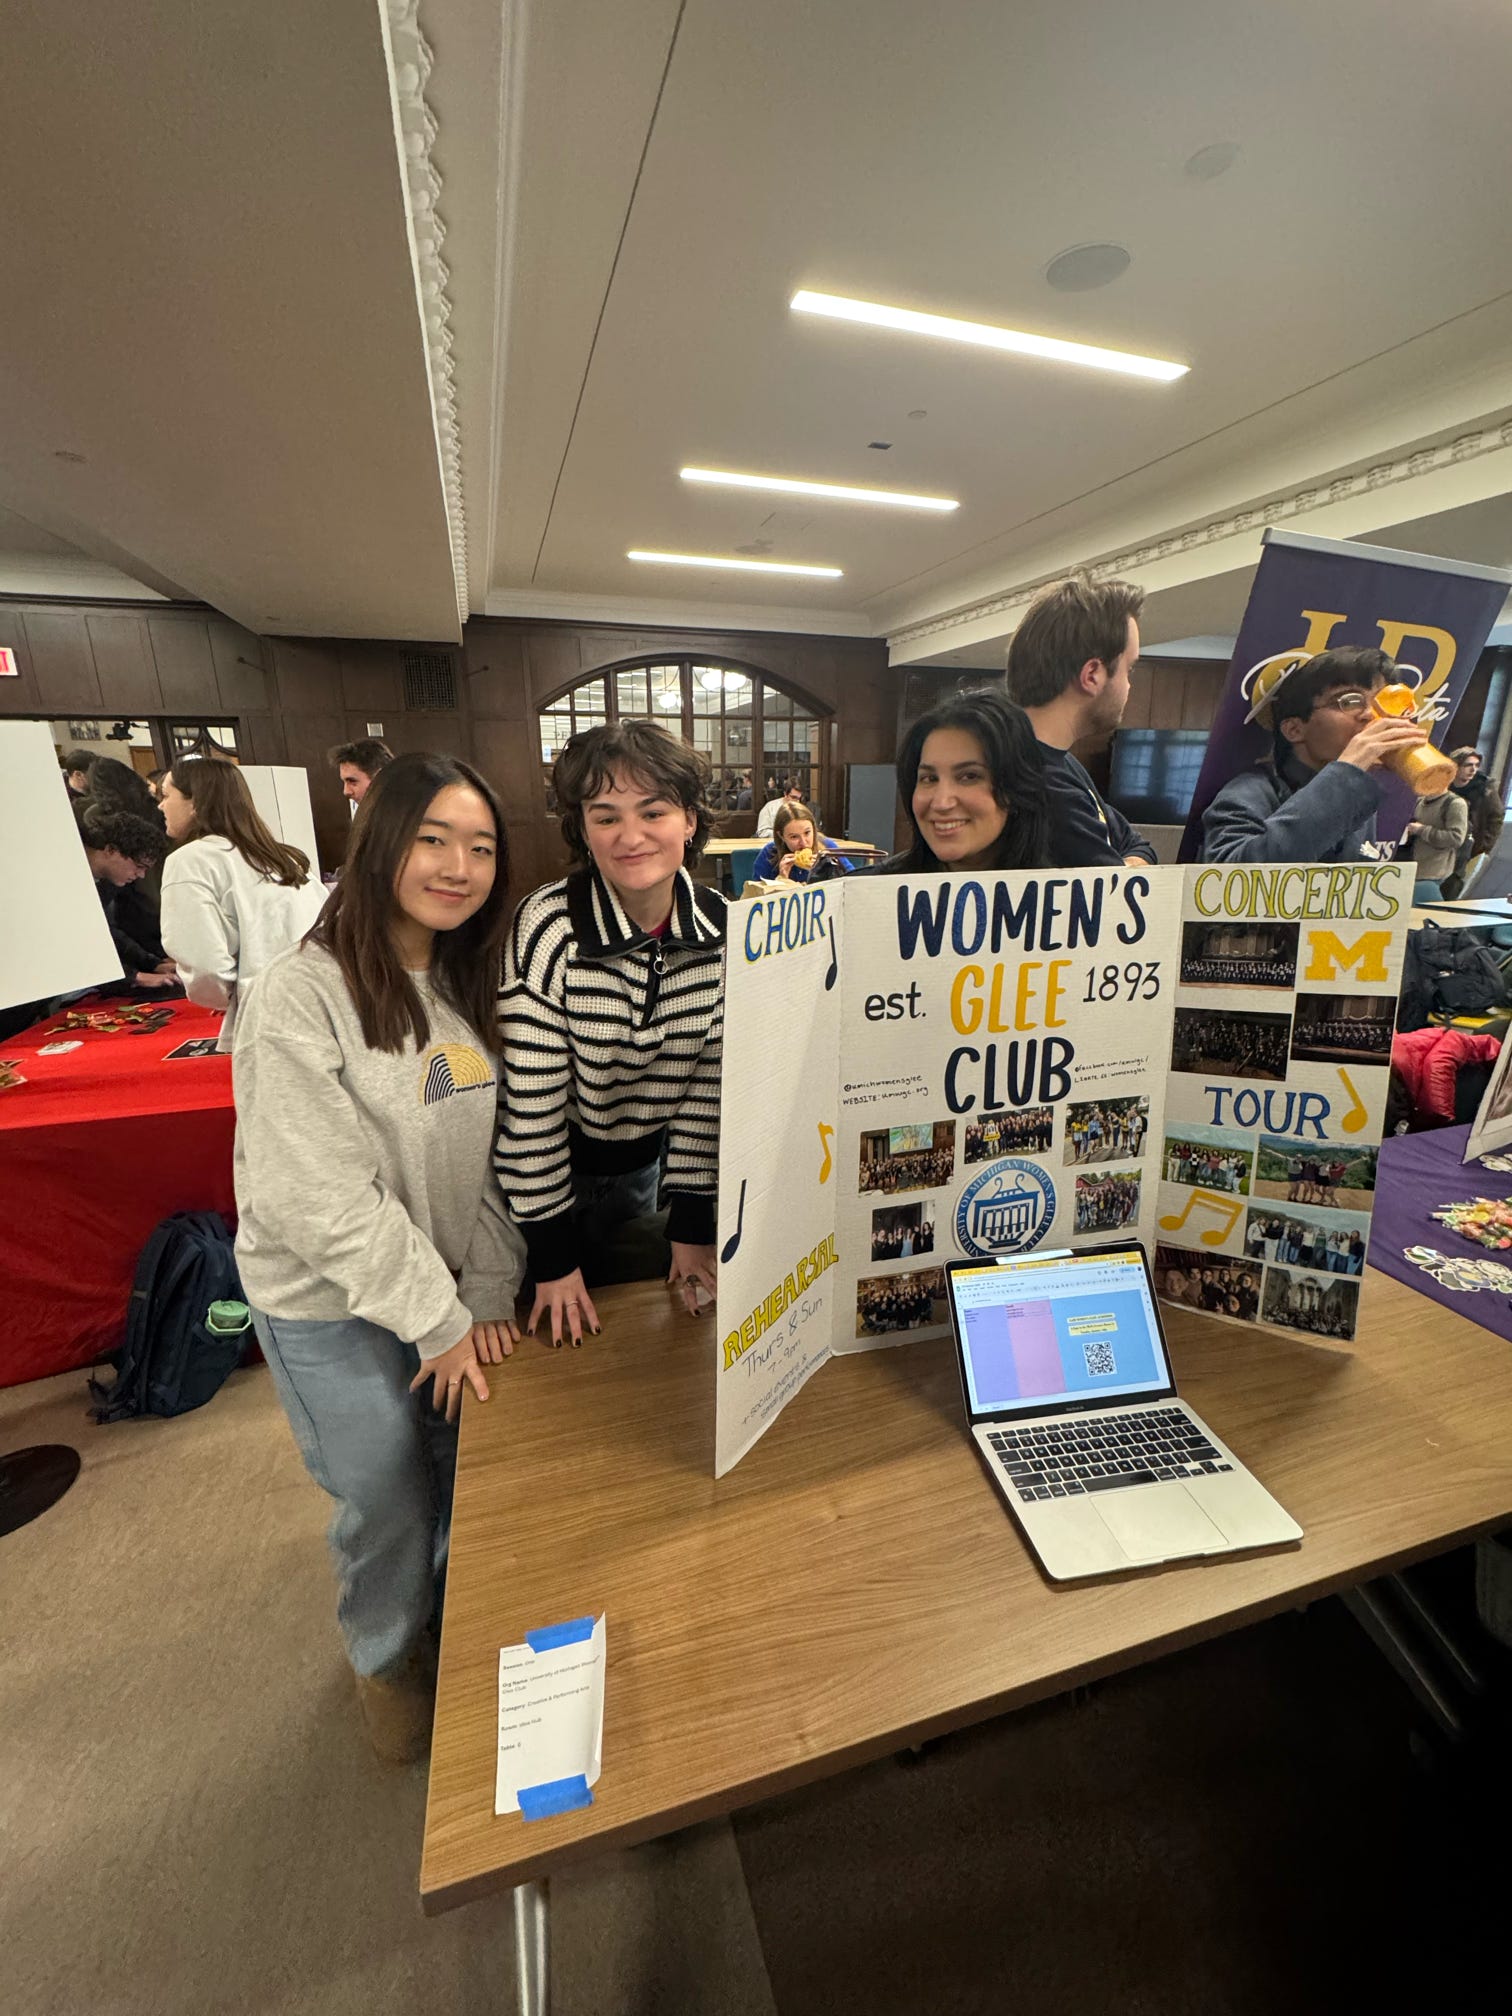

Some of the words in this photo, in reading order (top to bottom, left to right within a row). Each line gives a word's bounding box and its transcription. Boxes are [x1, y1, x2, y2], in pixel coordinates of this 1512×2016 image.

[897, 875, 1149, 960] WOMEN'S
[1194, 865, 1401, 921] CONCERTS
[745, 889, 826, 964] CHOIR
[1304, 930, 1393, 983] M
[864, 981, 927, 1022] est.
[1082, 961, 1161, 1003] 1893
[950, 959, 1072, 1035] GLEE
[944, 1036, 1075, 1114] CLUB
[1204, 1086, 1331, 1139] TOUR
[961, 1194, 971, 1208] OF
[969, 1160, 1020, 1193] MICHIGAN
[957, 1211, 985, 1257] NIVERSITY
[723, 1232, 839, 1372] REHEARSAL
[742, 1331, 784, 1376] Thurs
[801, 1298, 823, 1324] Sun
